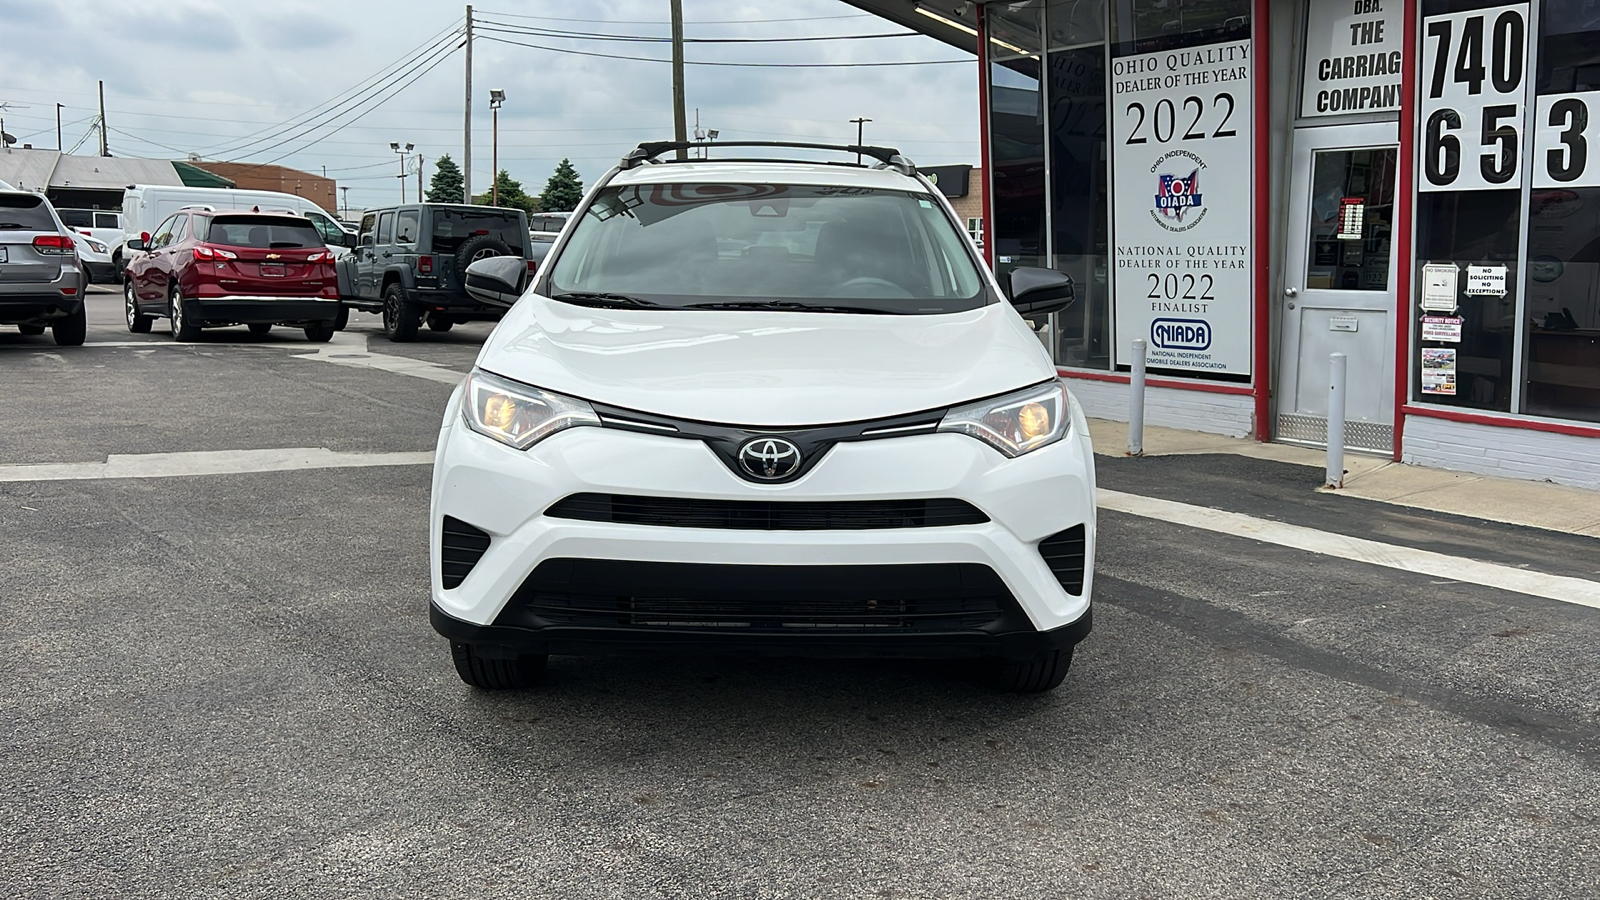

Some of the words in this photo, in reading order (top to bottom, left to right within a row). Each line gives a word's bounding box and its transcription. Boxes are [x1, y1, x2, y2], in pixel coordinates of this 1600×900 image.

[1350, 20, 1385, 46] THE
[1113, 57, 1158, 76] OHIO
[1166, 44, 1250, 71] QUALITY
[1318, 51, 1402, 81] CARRIAG
[1427, 10, 1525, 99] 740
[1116, 77, 1162, 94] DEALER
[1164, 75, 1181, 88] OF
[1183, 71, 1209, 86] THE
[1212, 66, 1248, 83] YEAR
[1125, 92, 1237, 145] 2022
[1150, 156, 1165, 174] OHIO
[1164, 149, 1208, 170] INDEPENDENT
[1160, 195, 1194, 207] OIADA
[1117, 246, 1182, 256] NATIONAL
[1187, 245, 1247, 257] QUALITY
[1119, 259, 1161, 268] DEALER
[1166, 259, 1180, 269] OF
[1185, 259, 1208, 269] THE
[1214, 260, 1246, 269] YEAR
[1147, 273, 1215, 301] 2022
[1151, 302, 1208, 313] FINALIST
[1156, 325, 1205, 344] NIADA
[1146, 357, 1169, 365] OMOBILE
[1169, 359, 1191, 367] DEALERS
[1191, 361, 1227, 369] ASSOCIATION
[1151, 350, 1176, 358] NATIONAL
[1177, 352, 1211, 360] INDEPENDENT
